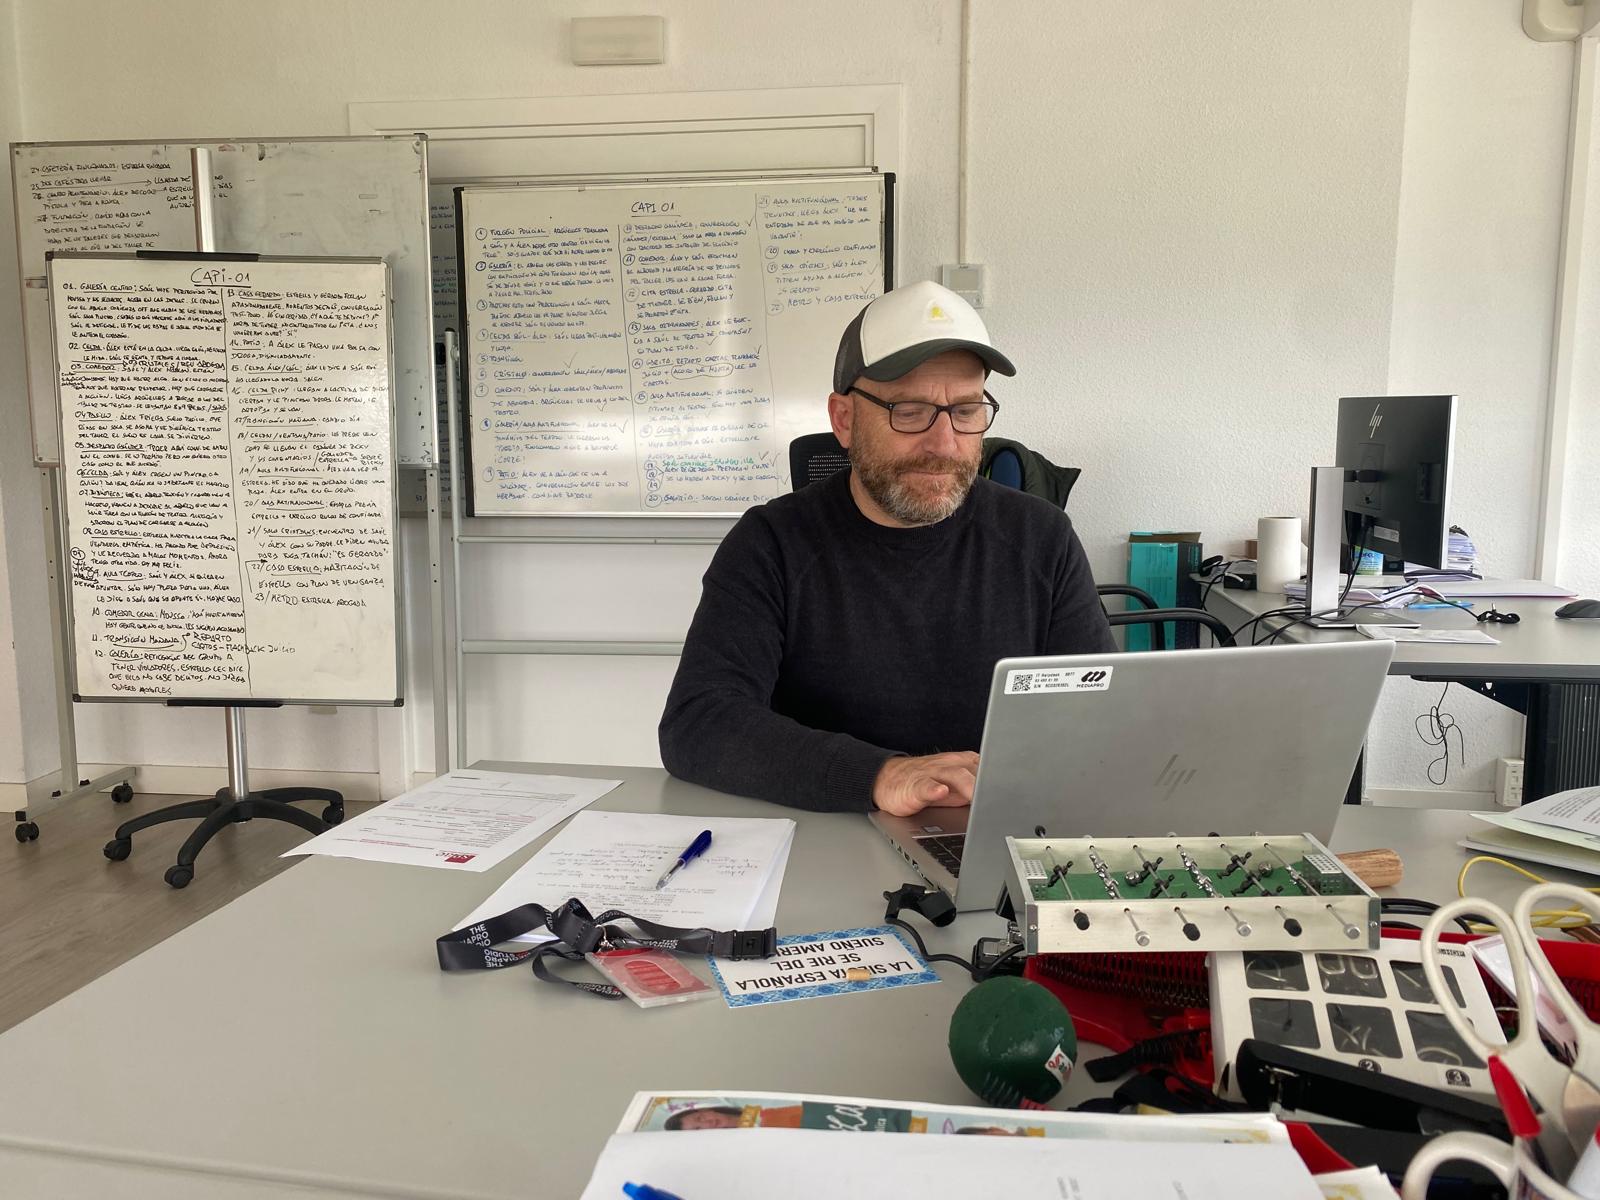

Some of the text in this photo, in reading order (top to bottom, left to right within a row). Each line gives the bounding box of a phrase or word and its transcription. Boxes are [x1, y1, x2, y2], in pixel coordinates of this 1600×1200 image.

[631, 202, 674, 213] CAPI 01
[1076, 682, 1105, 690] MEDIAPRO
[470, 924, 486, 935] THE
[463, 932, 488, 944] IAPRO
[832, 937, 885, 952] SUEÑO
[770, 953, 862, 972] SE RIE DEL
[888, 961, 914, 971] LA
[736, 971, 827, 992] ESPAÑOLA
